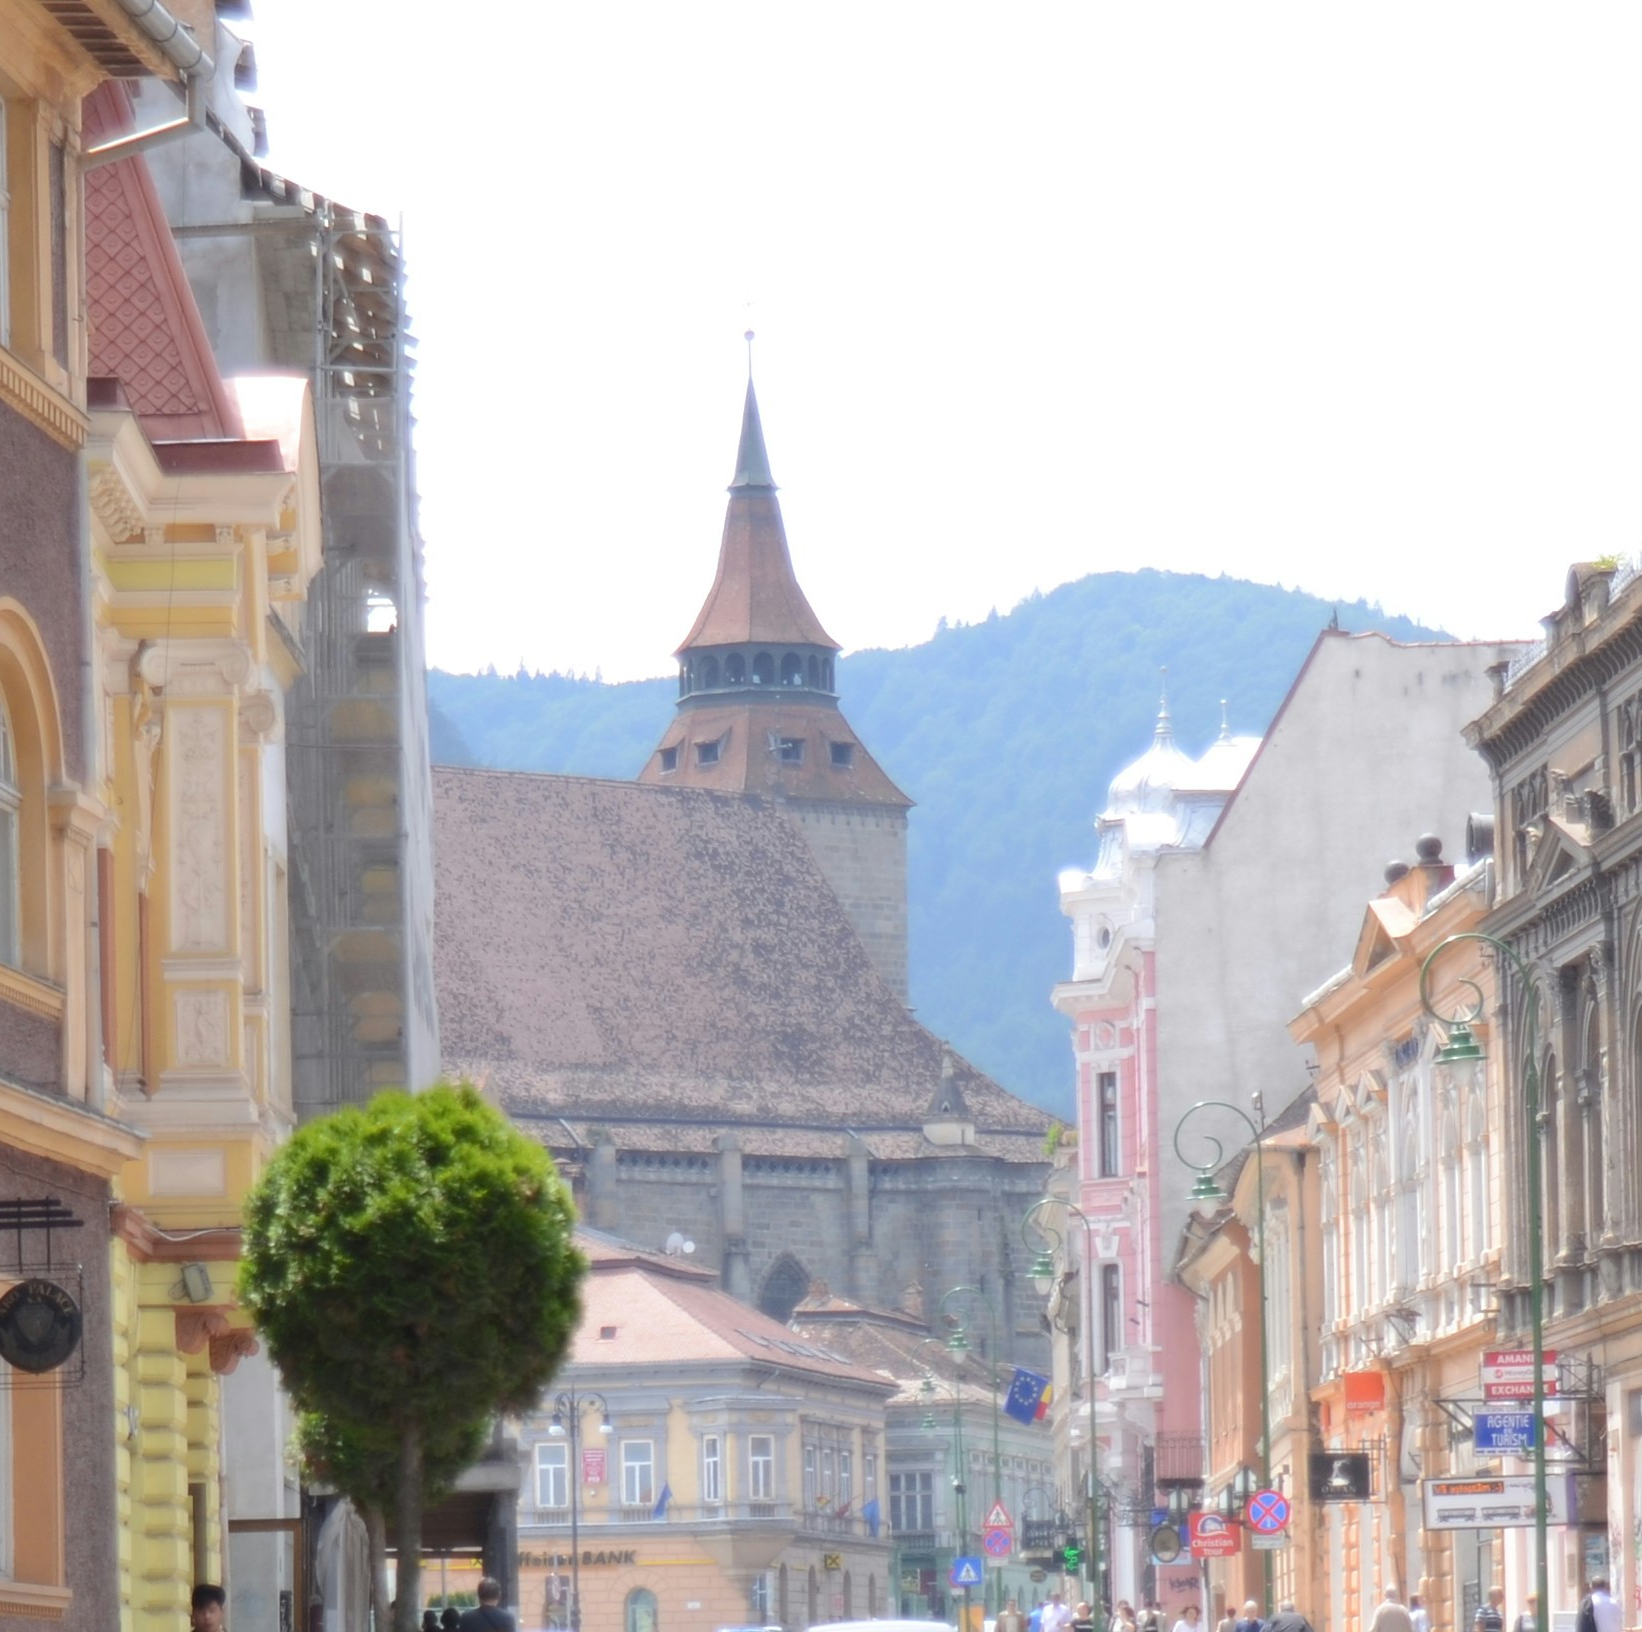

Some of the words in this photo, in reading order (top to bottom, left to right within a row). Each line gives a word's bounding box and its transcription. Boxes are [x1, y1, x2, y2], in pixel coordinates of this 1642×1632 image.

[28, 1283, 75, 1317] PALACE
[1491, 1384, 1549, 1395] EXCHANE
[1491, 1434, 1528, 1447] TURISM
[1192, 1537, 1234, 1548] Christian
[582, 1549, 636, 1566] BANK
